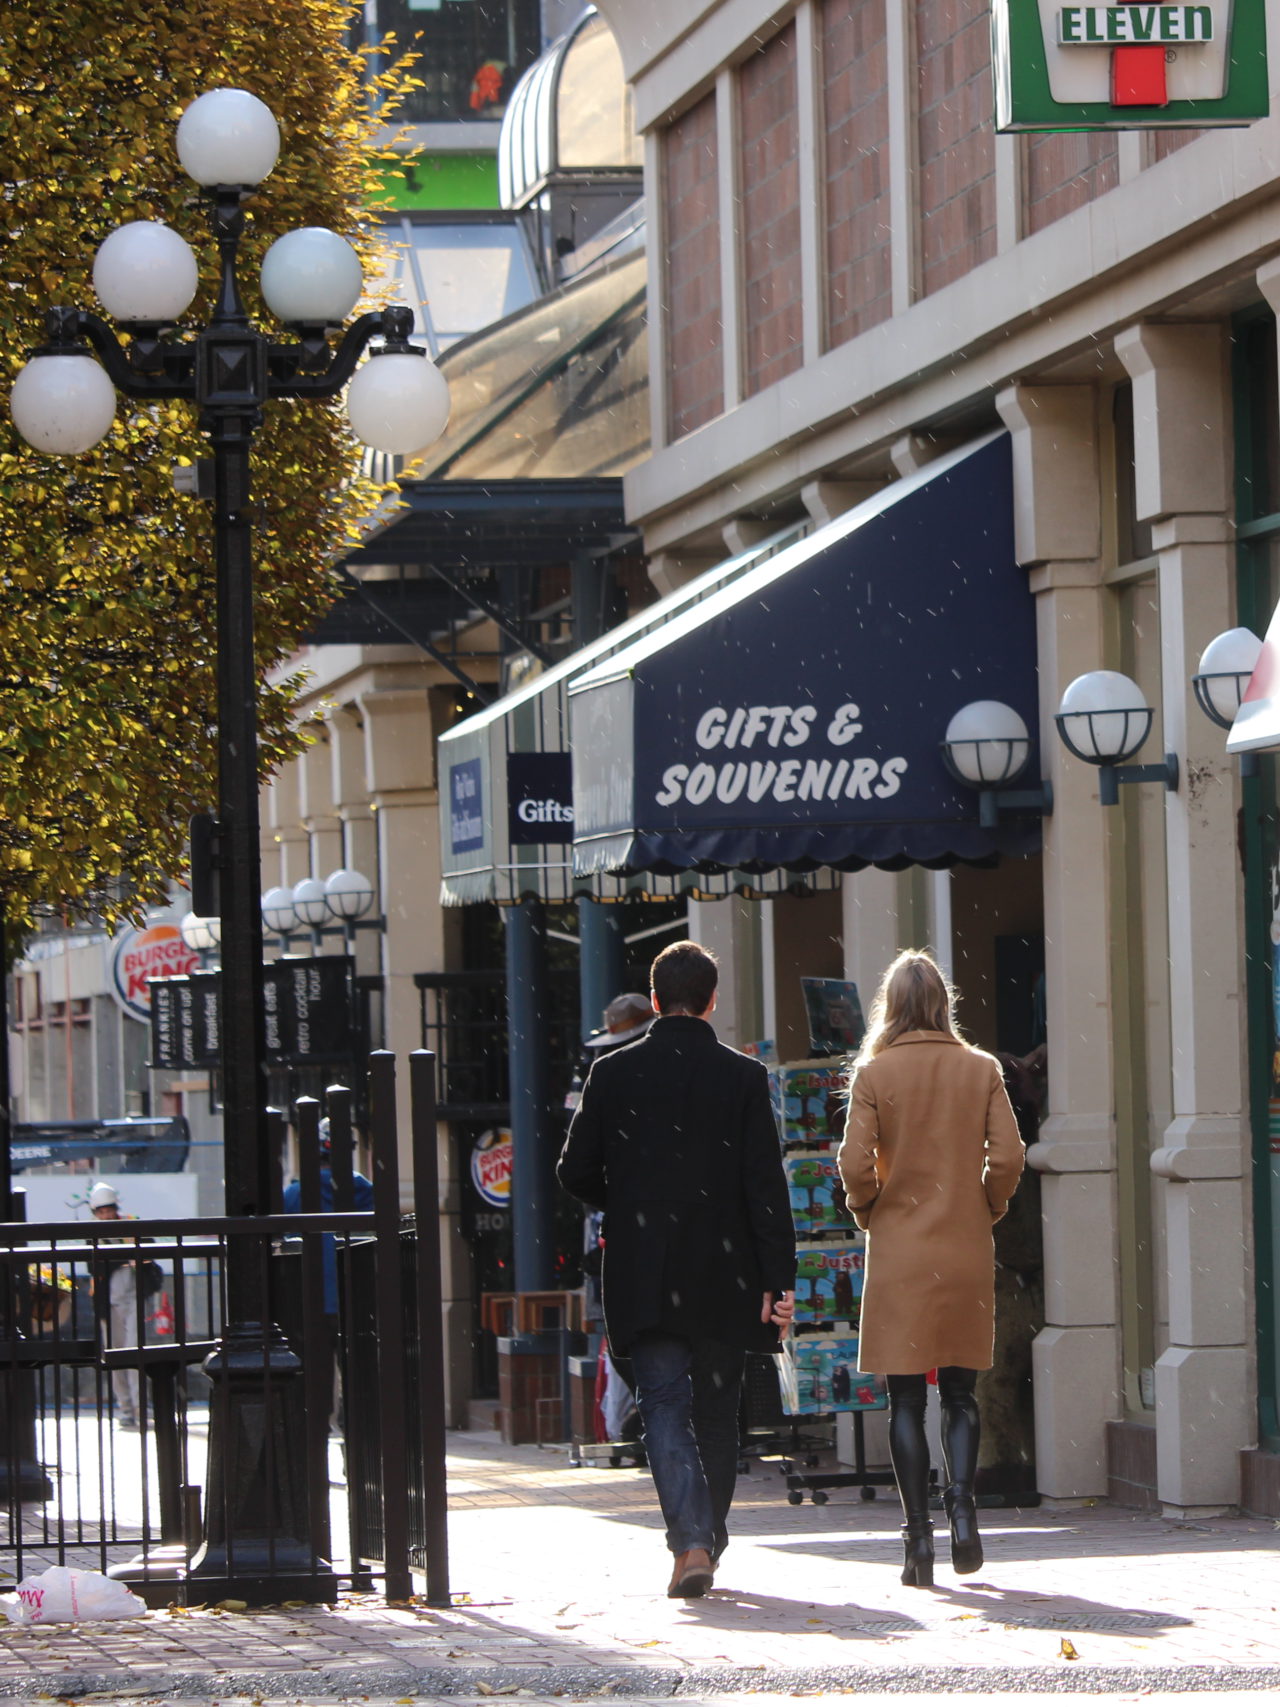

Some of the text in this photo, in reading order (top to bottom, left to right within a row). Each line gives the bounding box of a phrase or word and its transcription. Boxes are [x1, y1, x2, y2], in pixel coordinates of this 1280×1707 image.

[695, 703, 863, 750] GIFTS &
[655, 757, 908, 807] SOUVENIRS
[517, 799, 575, 823] Gifts
[158, 987, 171, 1061] FRANKIES
[181, 1008, 193, 1026] on
[204, 992, 219, 1050] breakfast
[264, 982, 281, 1049] great eats
[182, 1026, 194, 1062] come
[481, 1159, 513, 1188] KIN
